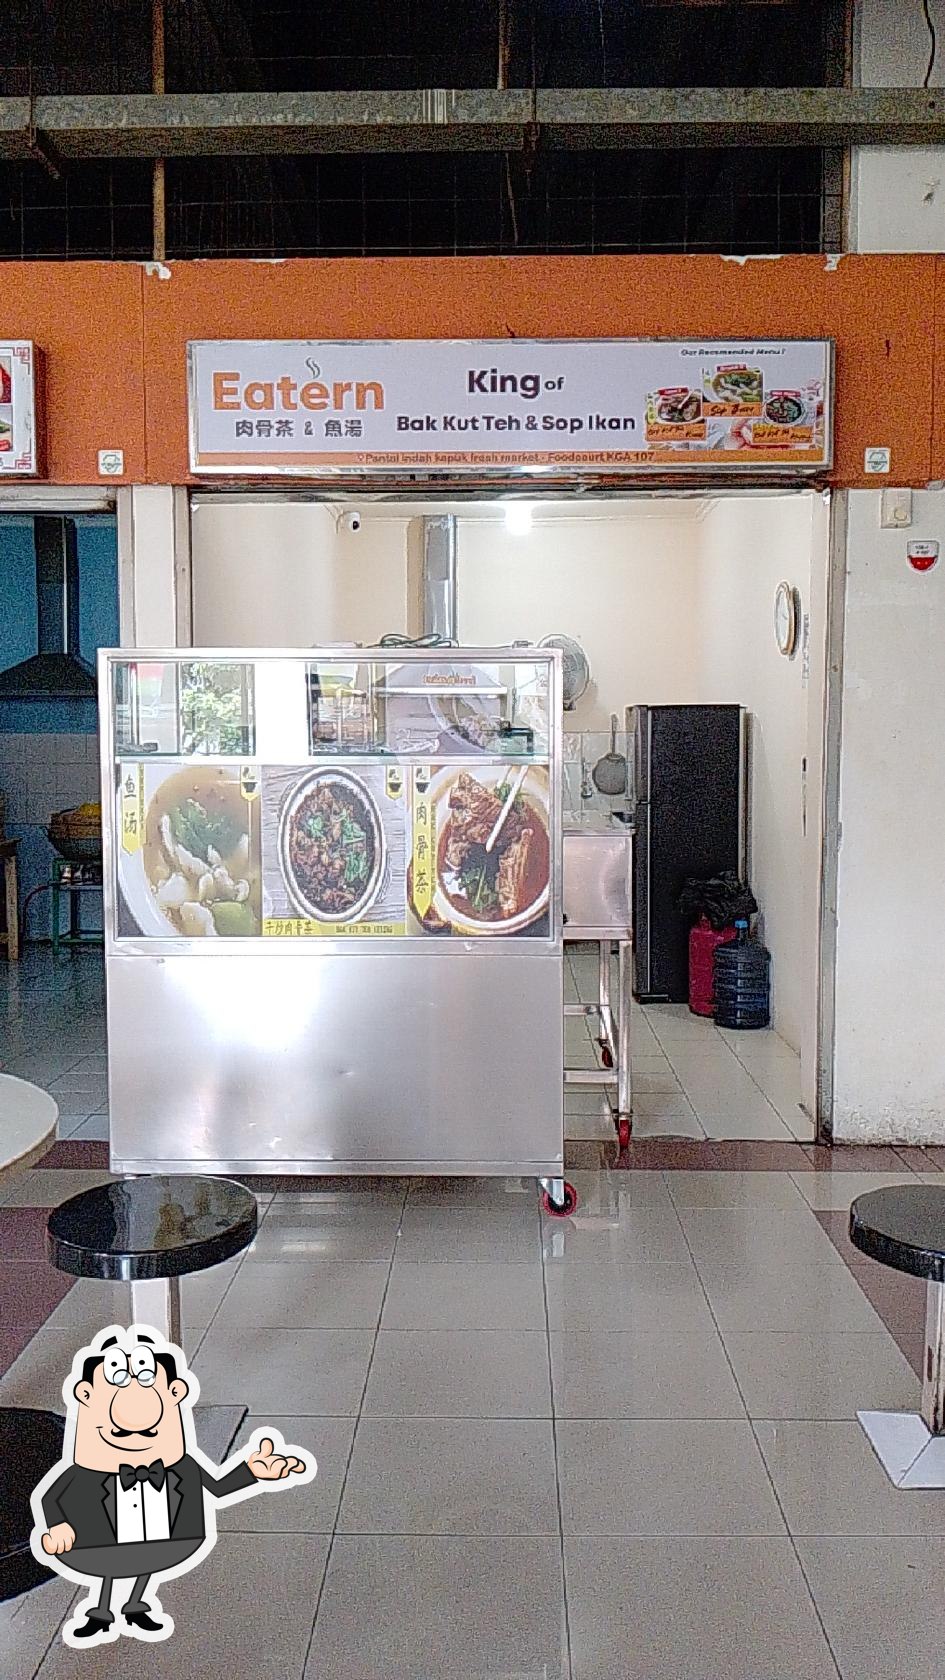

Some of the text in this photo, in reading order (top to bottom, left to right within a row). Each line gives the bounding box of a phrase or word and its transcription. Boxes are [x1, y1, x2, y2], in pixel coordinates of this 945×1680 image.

[212, 371, 385, 411] Eatern
[467, 368, 564, 399] King of
[235, 419, 363, 438] 肉骨茶 & 魚湯
[396, 414, 636, 434] Bak Kut Teh & Sop Ikan
[548, 452, 604, 463] Foodcourt
